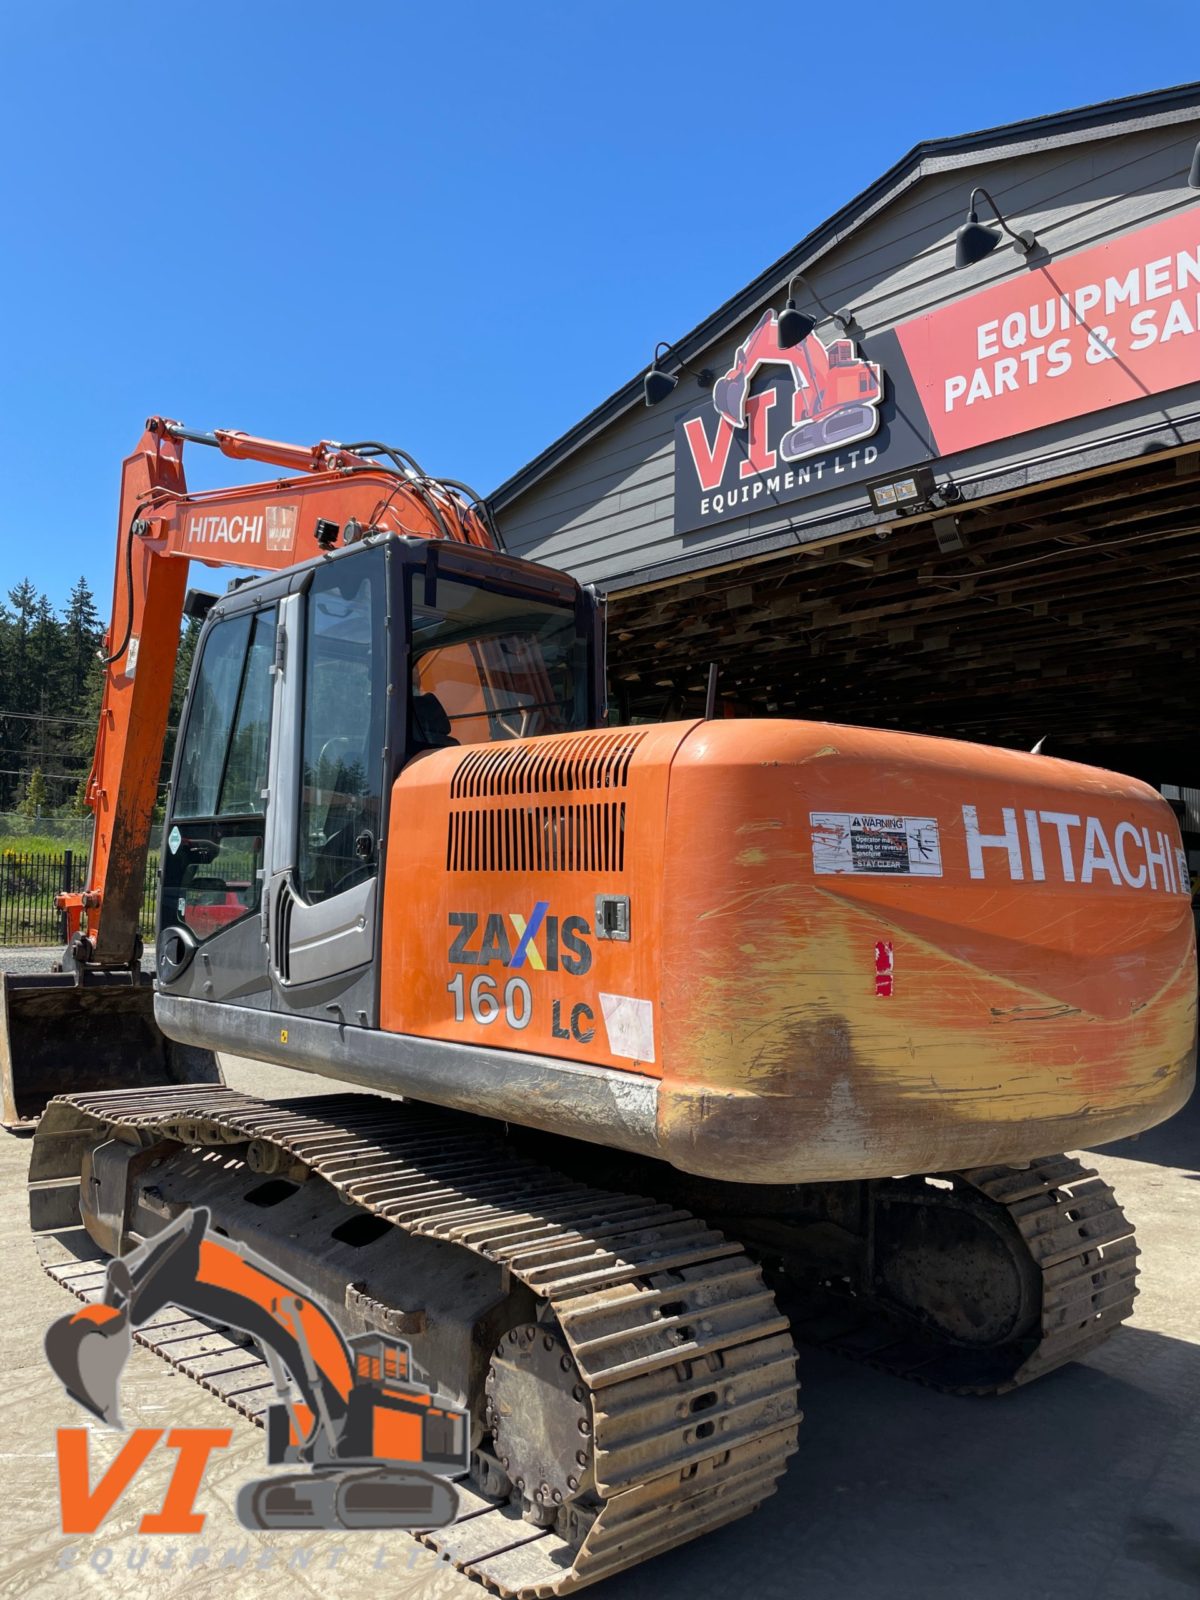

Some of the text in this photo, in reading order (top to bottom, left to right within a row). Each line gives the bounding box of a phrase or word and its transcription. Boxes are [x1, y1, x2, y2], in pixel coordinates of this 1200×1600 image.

[977, 244, 1200, 360] EQUIPMEN
[945, 292, 1200, 413] PARTS & SA
[683, 387, 777, 492] VI
[701, 446, 878, 515] EQUIPMENT LTD
[188, 515, 264, 543] HITACHI
[855, 836, 880, 844] Operator
[861, 818, 903, 829] WARNING
[962, 804, 1178, 894] HITACHI
[877, 860, 901, 868] CLEAR
[448, 901, 592, 975] ZAXIS
[447, 972, 595, 1043] 160 LC
